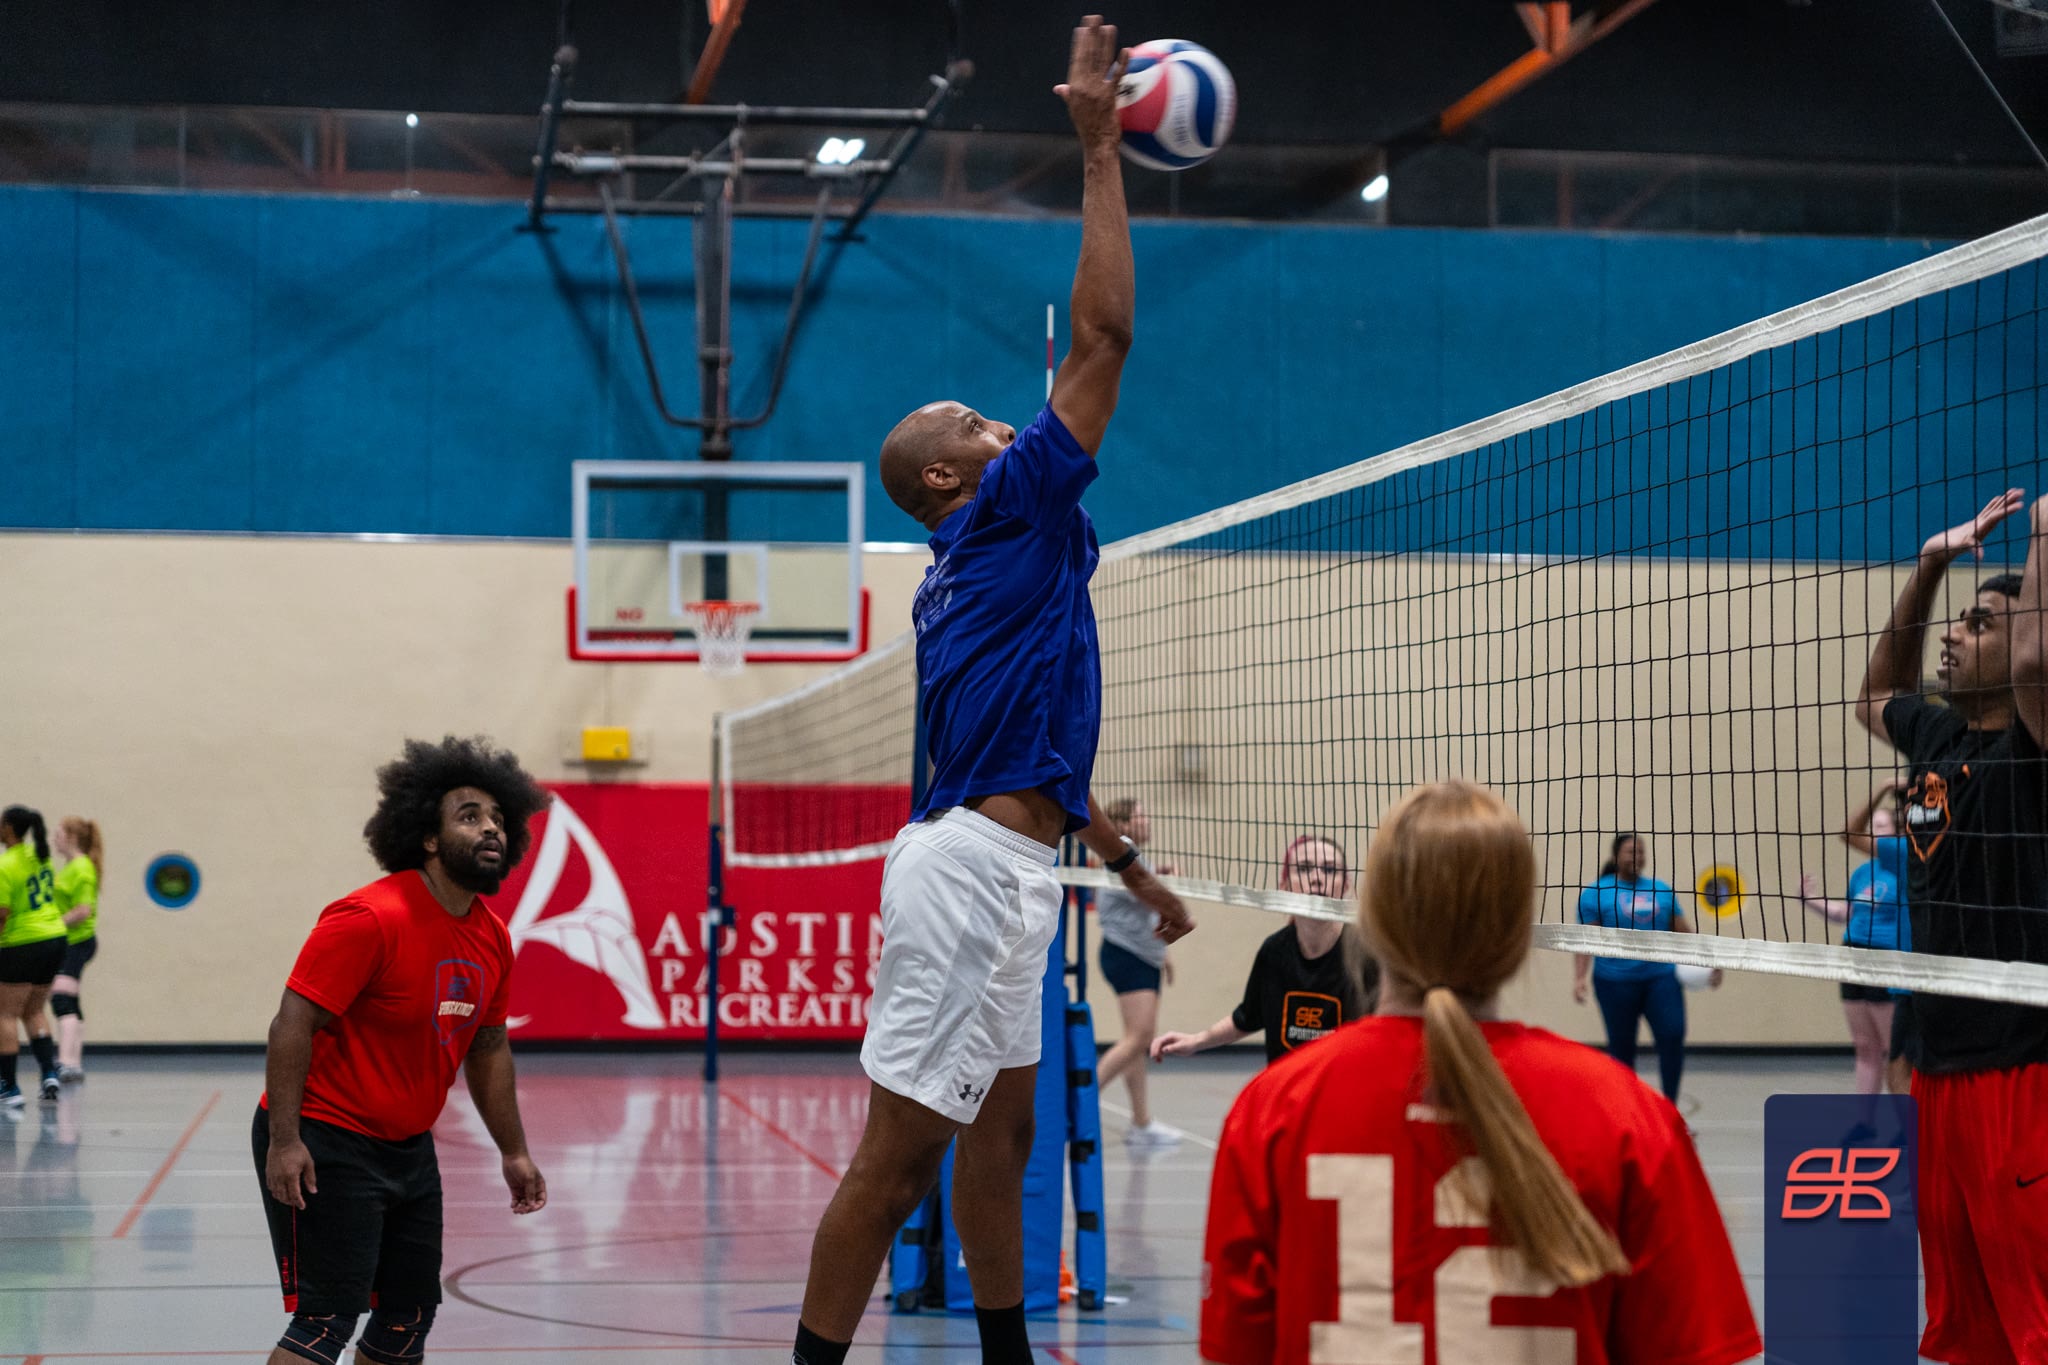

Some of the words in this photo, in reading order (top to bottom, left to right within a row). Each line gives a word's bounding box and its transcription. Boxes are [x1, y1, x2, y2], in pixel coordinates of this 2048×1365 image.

[26, 869, 54, 910] 23
[669, 993, 872, 1027] RCREATI
[1306, 1153, 1577, 1365] 12
